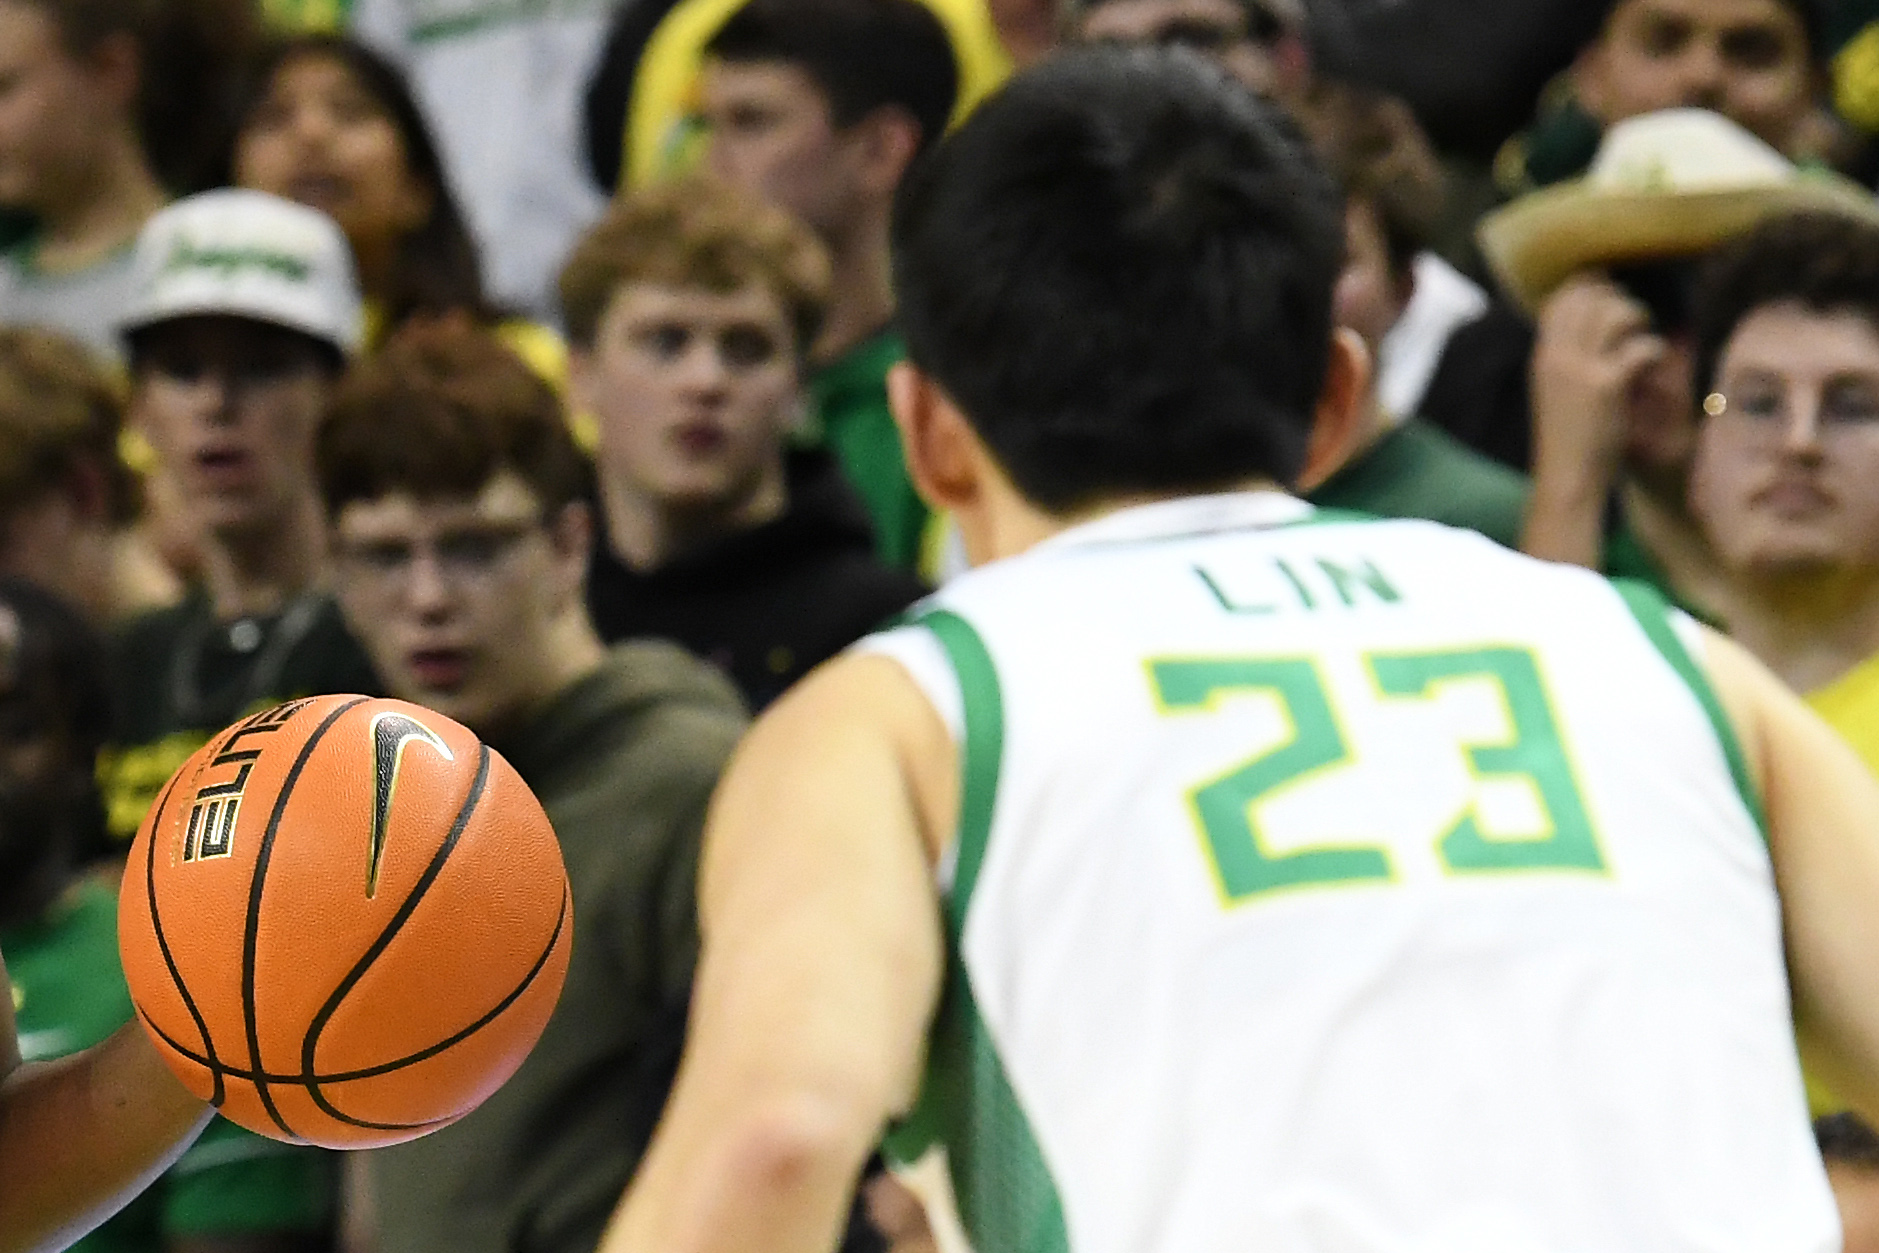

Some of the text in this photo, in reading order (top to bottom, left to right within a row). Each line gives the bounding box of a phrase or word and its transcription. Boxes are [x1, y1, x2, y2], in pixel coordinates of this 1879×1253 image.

[1192, 555, 1404, 616] LIN
[182, 697, 318, 863] ELITE
[1142, 644, 1612, 906] 23
